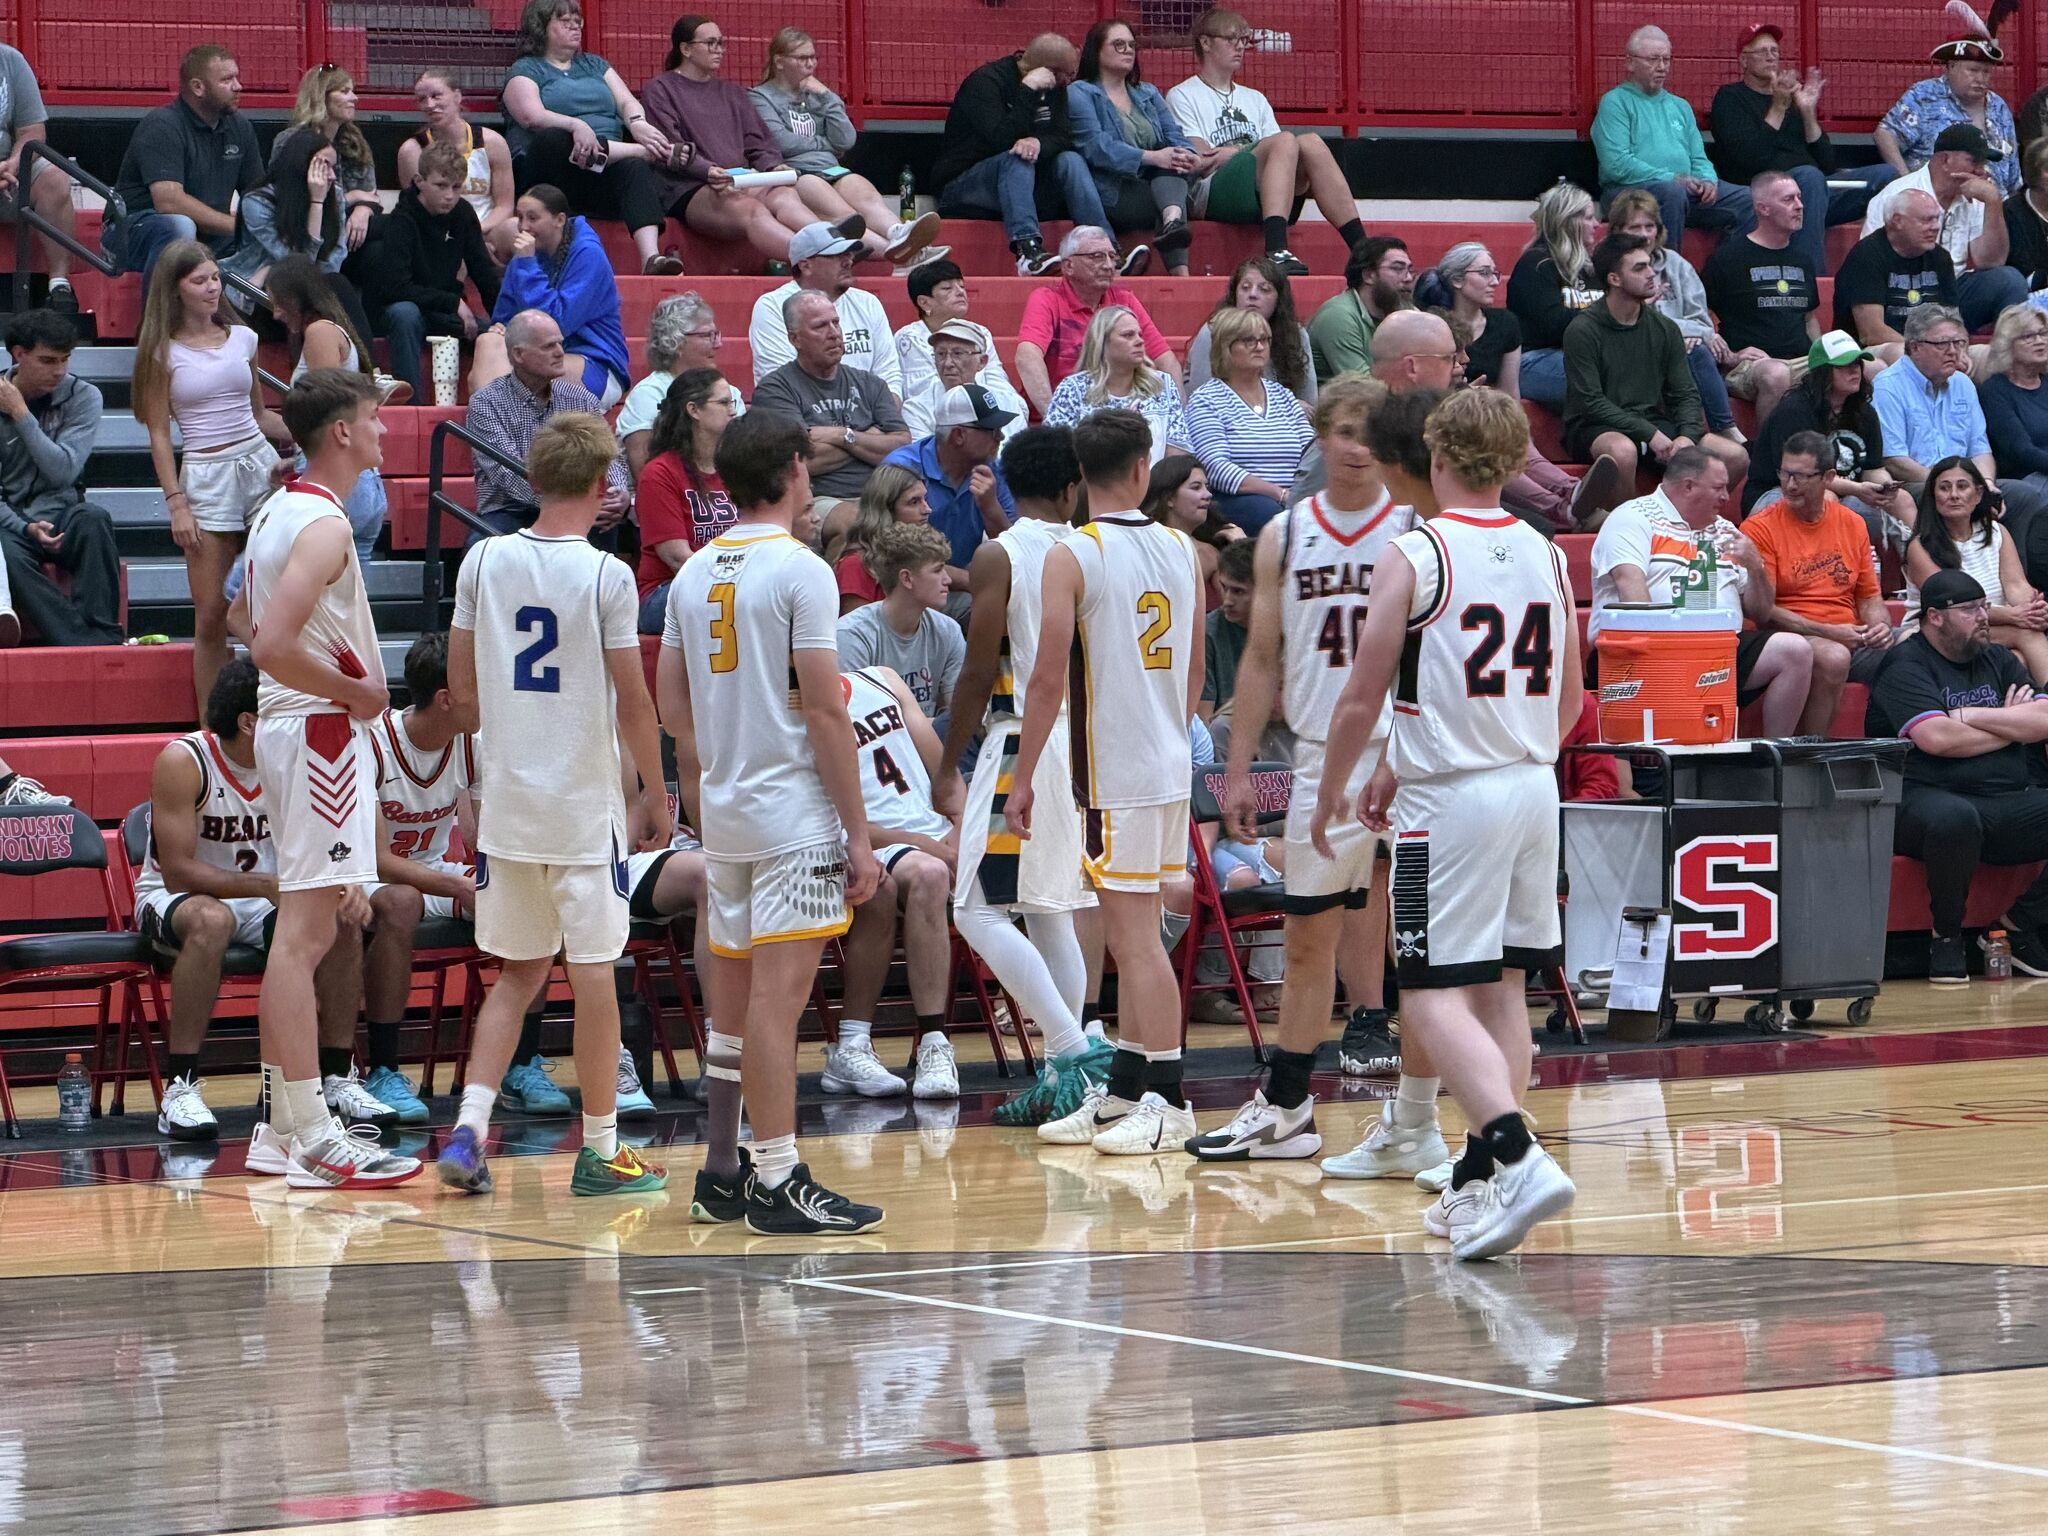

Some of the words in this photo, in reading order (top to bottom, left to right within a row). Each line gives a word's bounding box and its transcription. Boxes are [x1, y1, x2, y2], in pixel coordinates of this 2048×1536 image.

[685, 489, 740, 525] US
[1293, 562, 1375, 601] BEAC
[706, 582, 739, 674] 3
[1136, 591, 1172, 670] 2
[513, 605, 561, 693] 2
[1459, 602, 1554, 698] 24
[852, 704, 905, 750] ACH
[872, 745, 911, 796] 4
[1204, 770, 1292, 793] SAUSKY
[1214, 788, 1290, 813] WVES
[0, 814, 75, 839] NDUSKY
[200, 814, 272, 843] BEAC
[390, 826, 437, 859] 21
[0, 834, 73, 861] OLVES
[1673, 834, 1779, 962] S
